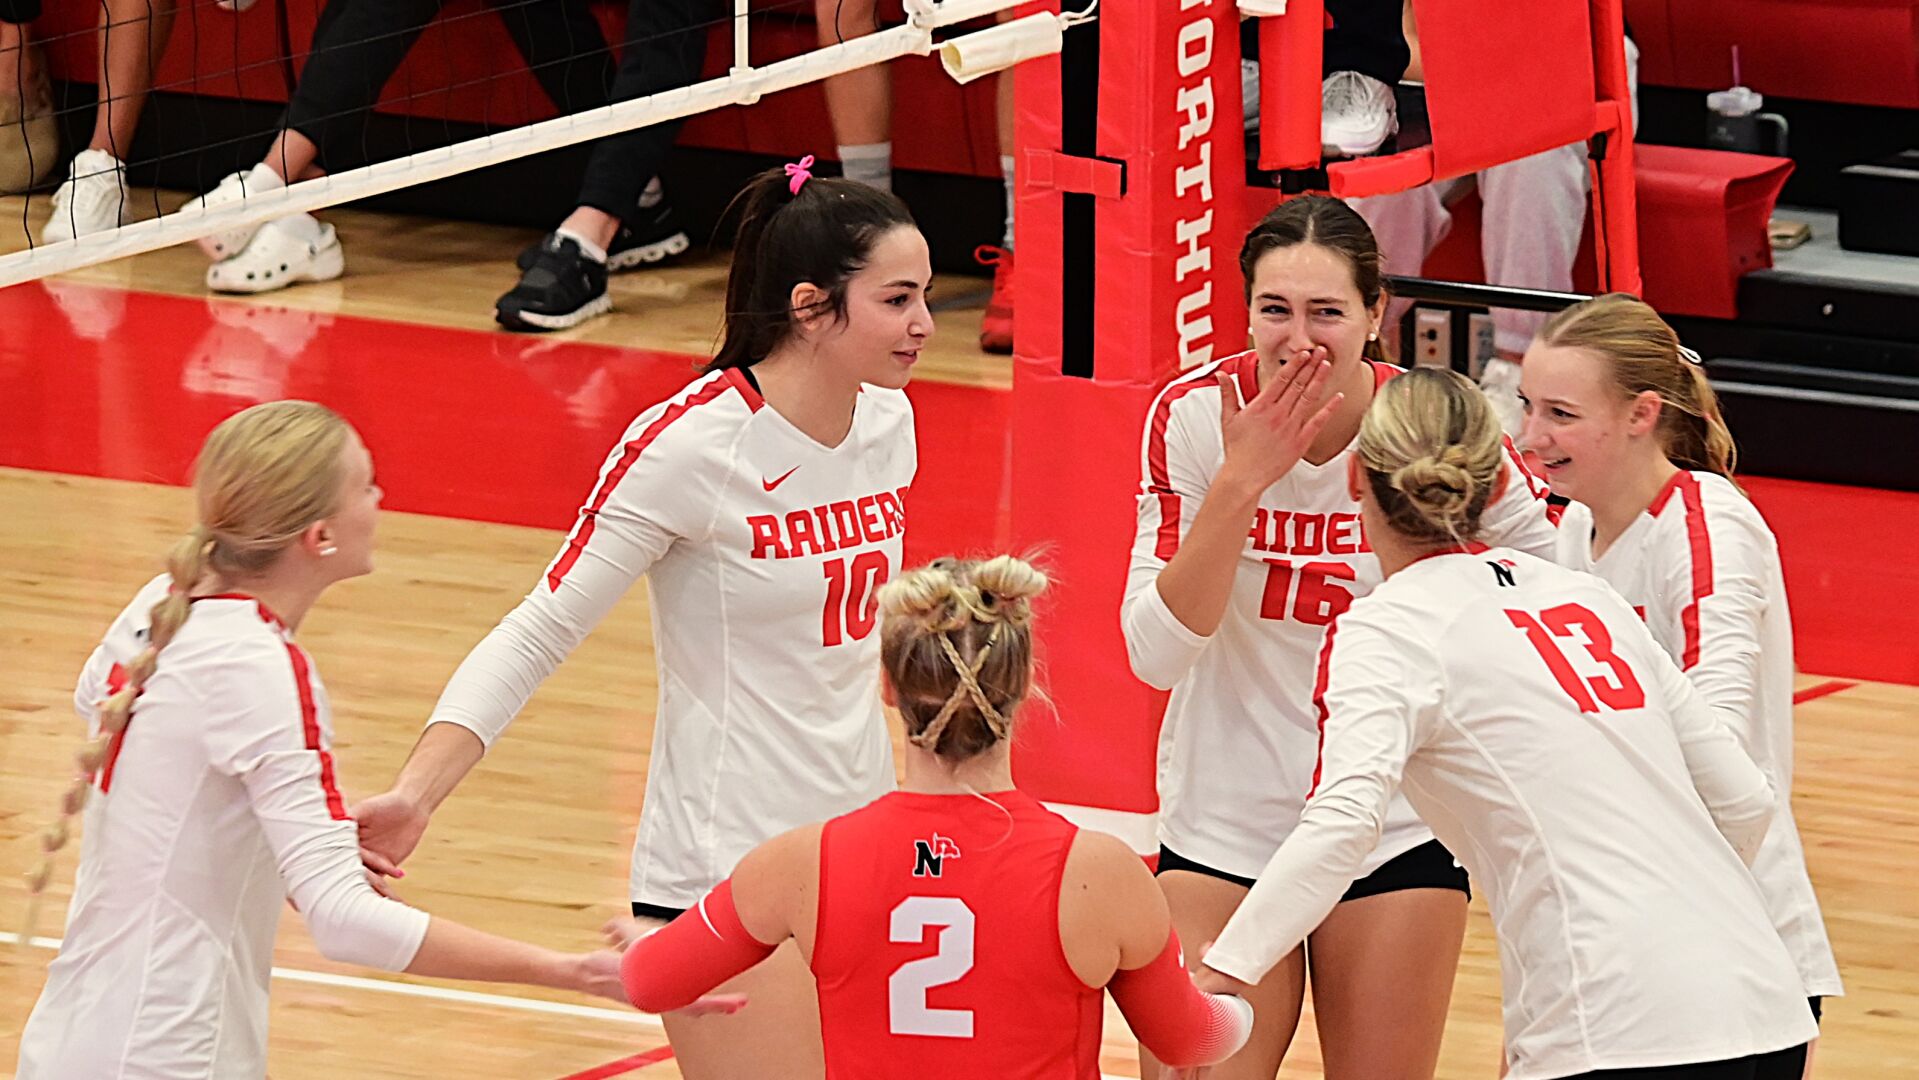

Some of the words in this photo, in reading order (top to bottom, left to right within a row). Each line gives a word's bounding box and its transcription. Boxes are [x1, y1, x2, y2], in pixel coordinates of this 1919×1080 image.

[1175, 0, 1213, 371] ORTHW
[822, 550, 889, 647] 10
[1260, 557, 1356, 627] 16
[1503, 602, 1645, 714] 13
[912, 839, 944, 878] N
[888, 896, 976, 1038] 2
